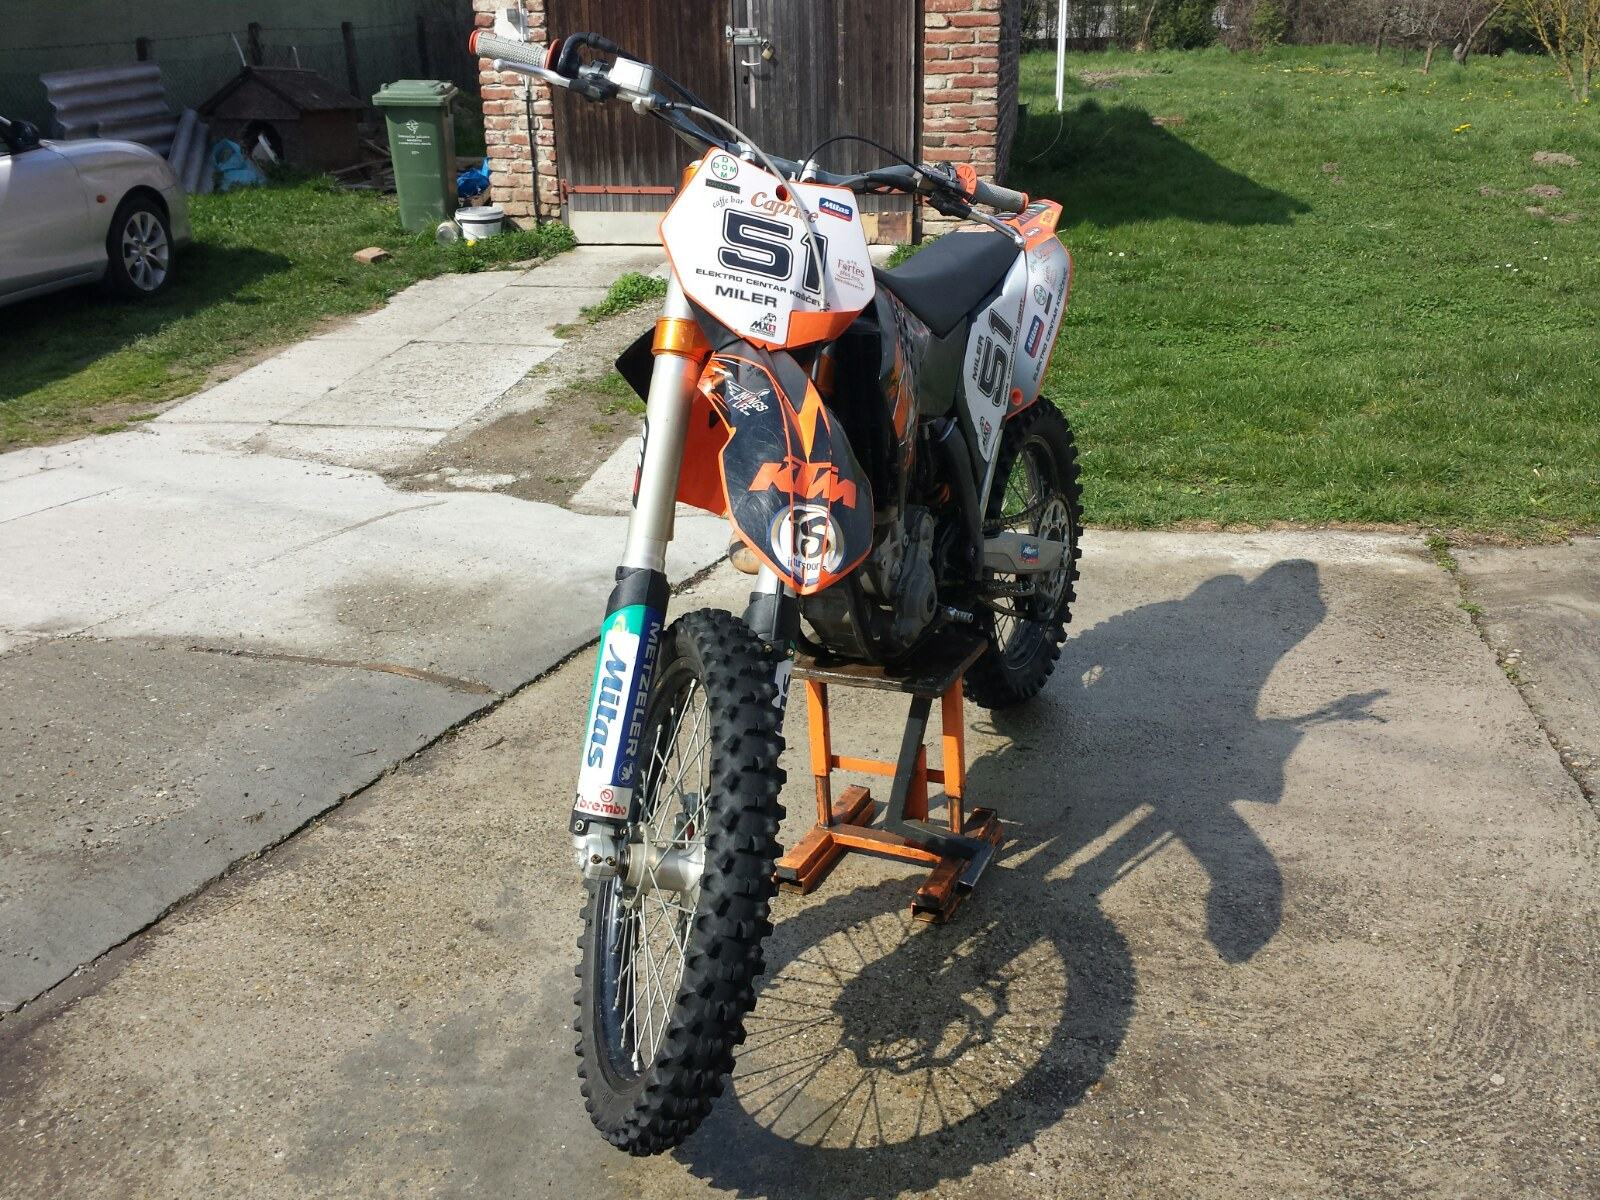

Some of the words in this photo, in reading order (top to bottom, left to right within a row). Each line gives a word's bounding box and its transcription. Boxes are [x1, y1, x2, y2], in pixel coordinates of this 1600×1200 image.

[730, 195, 744, 204] bar
[822, 200, 850, 215] Mitas
[695, 268, 743, 283] ELEKTRO
[745, 278, 787, 293] CENTAR
[715, 285, 778, 308] MILER
[1045, 306, 1059, 343] CENTAR
[972, 335, 985, 381] MILER
[748, 455, 856, 509] KTM
[625, 621, 662, 756] METZELER
[588, 643, 627, 770] Mitas
[579, 796, 627, 816] brembo
